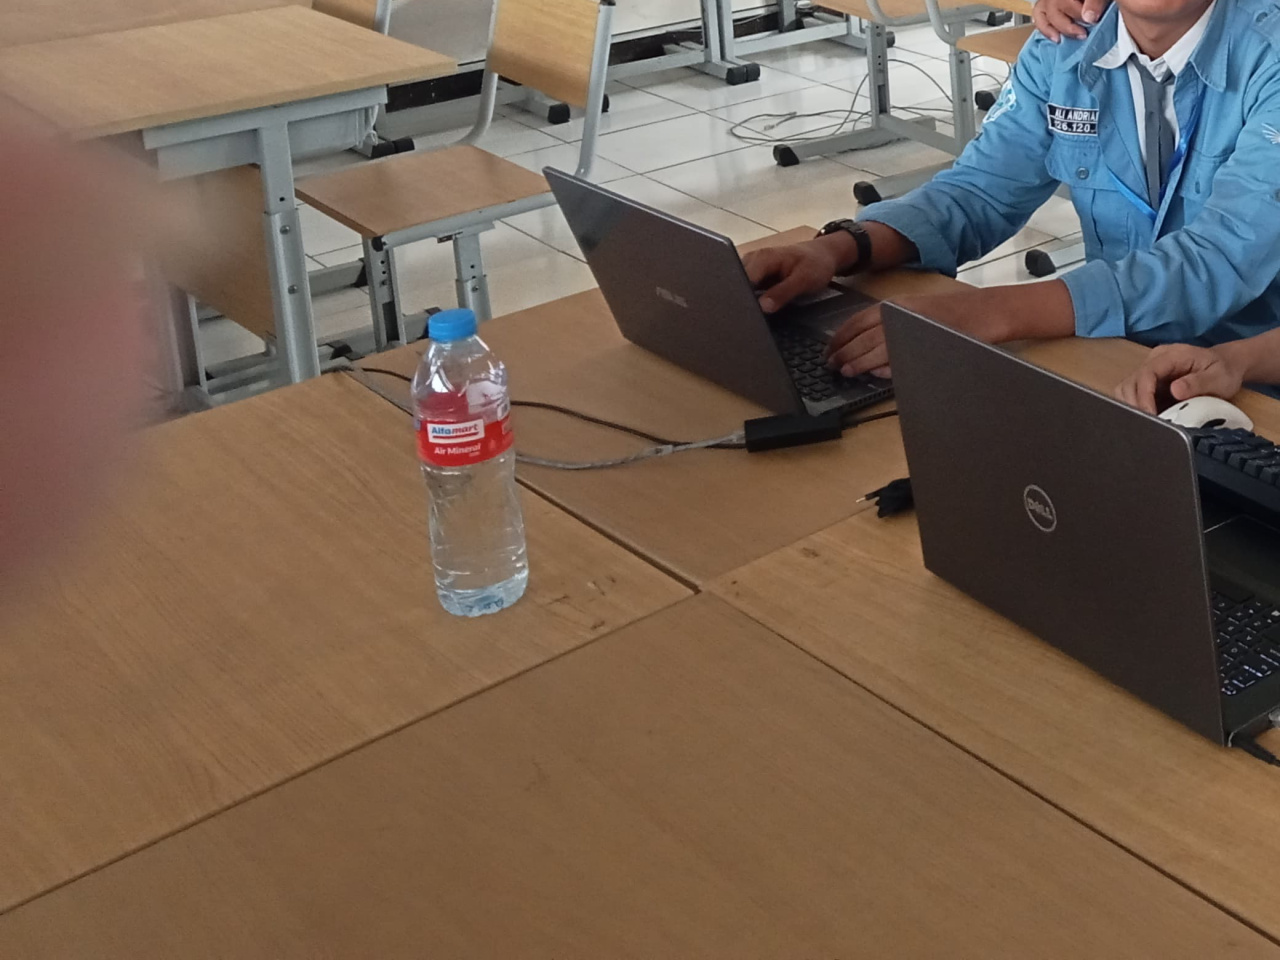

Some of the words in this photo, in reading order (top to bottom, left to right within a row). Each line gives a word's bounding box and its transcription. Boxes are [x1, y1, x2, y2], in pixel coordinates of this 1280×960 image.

[1054, 108, 1065, 120] ALI
[432, 423, 479, 435] Alfamart
[434, 446, 447, 455] Air
[447, 442, 482, 455] Mineral
